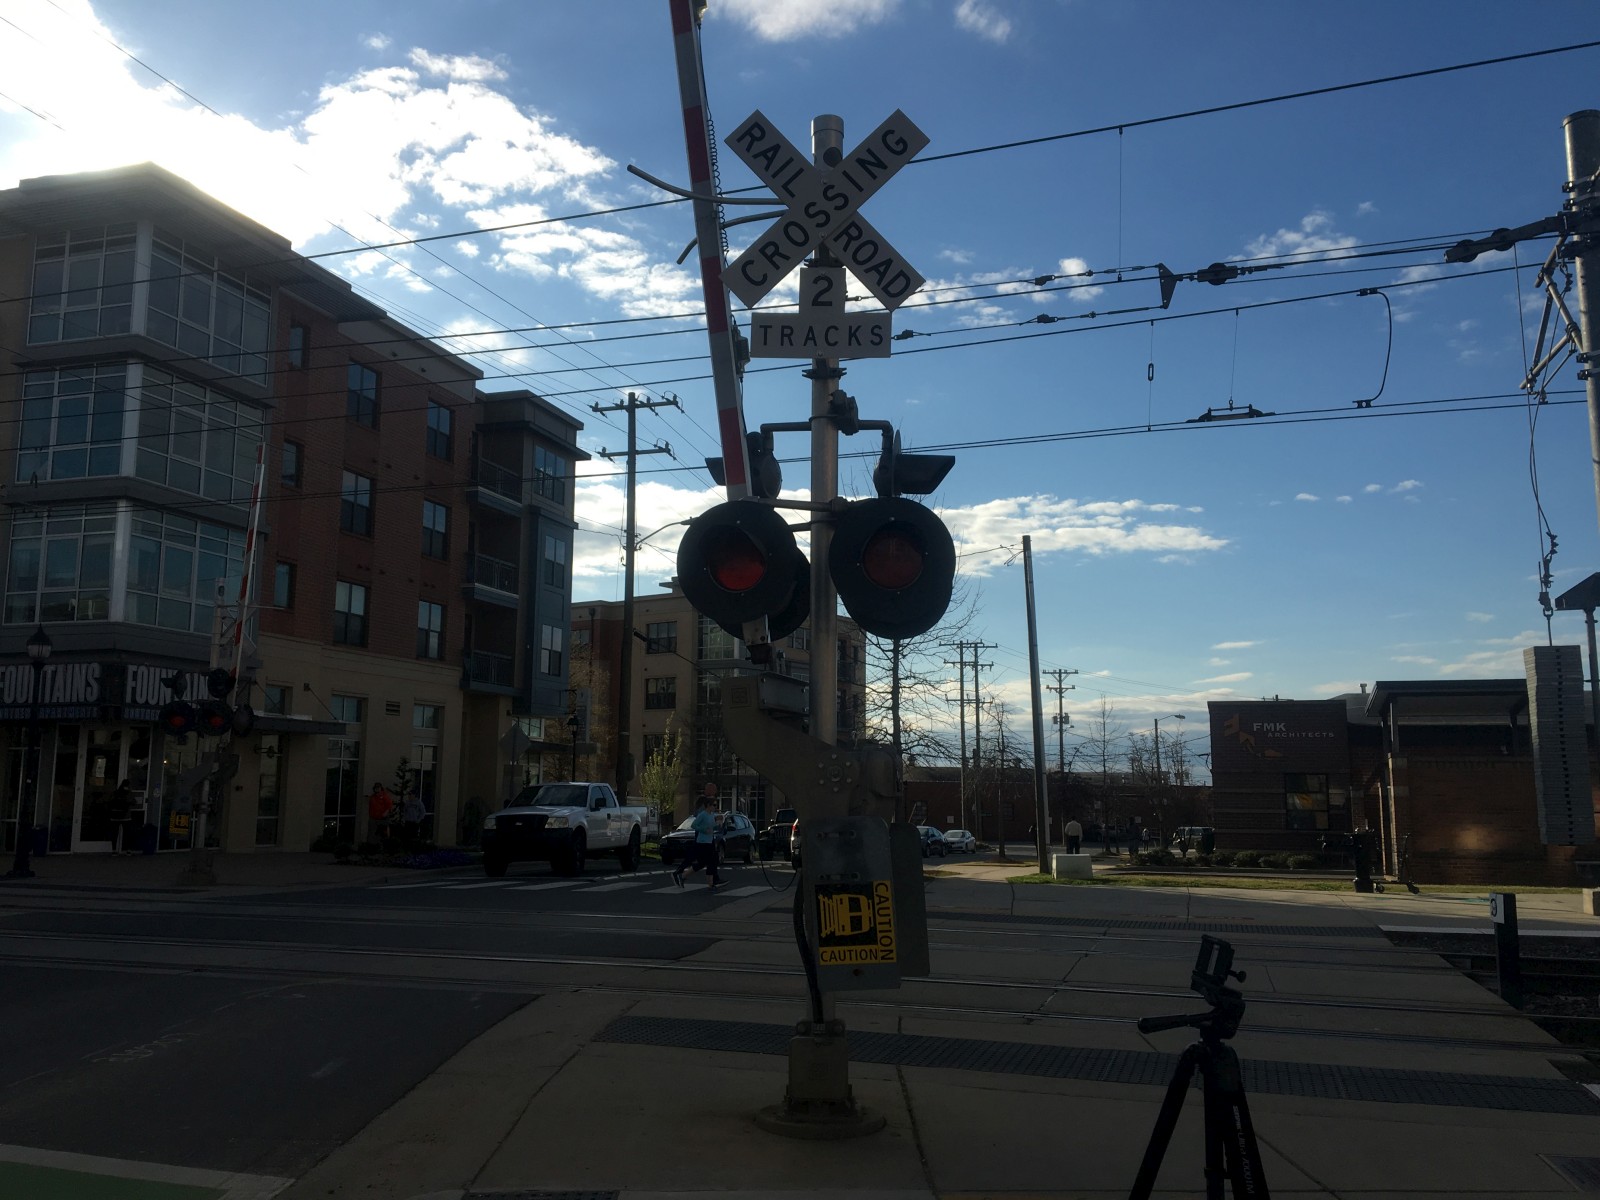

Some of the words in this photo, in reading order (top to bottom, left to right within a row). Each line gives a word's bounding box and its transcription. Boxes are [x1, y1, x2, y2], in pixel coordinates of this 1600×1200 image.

[736, 121, 804, 198] RAIL
[741, 129, 909, 287] CROSSING
[833, 221, 911, 298] ROAD
[811, 275, 833, 307] 2
[759, 324, 883, 347] TRACKS
[1252, 722, 1287, 732] FMK
[875, 882, 894, 961] CAUTION
[820, 948, 878, 962] CAUTION
